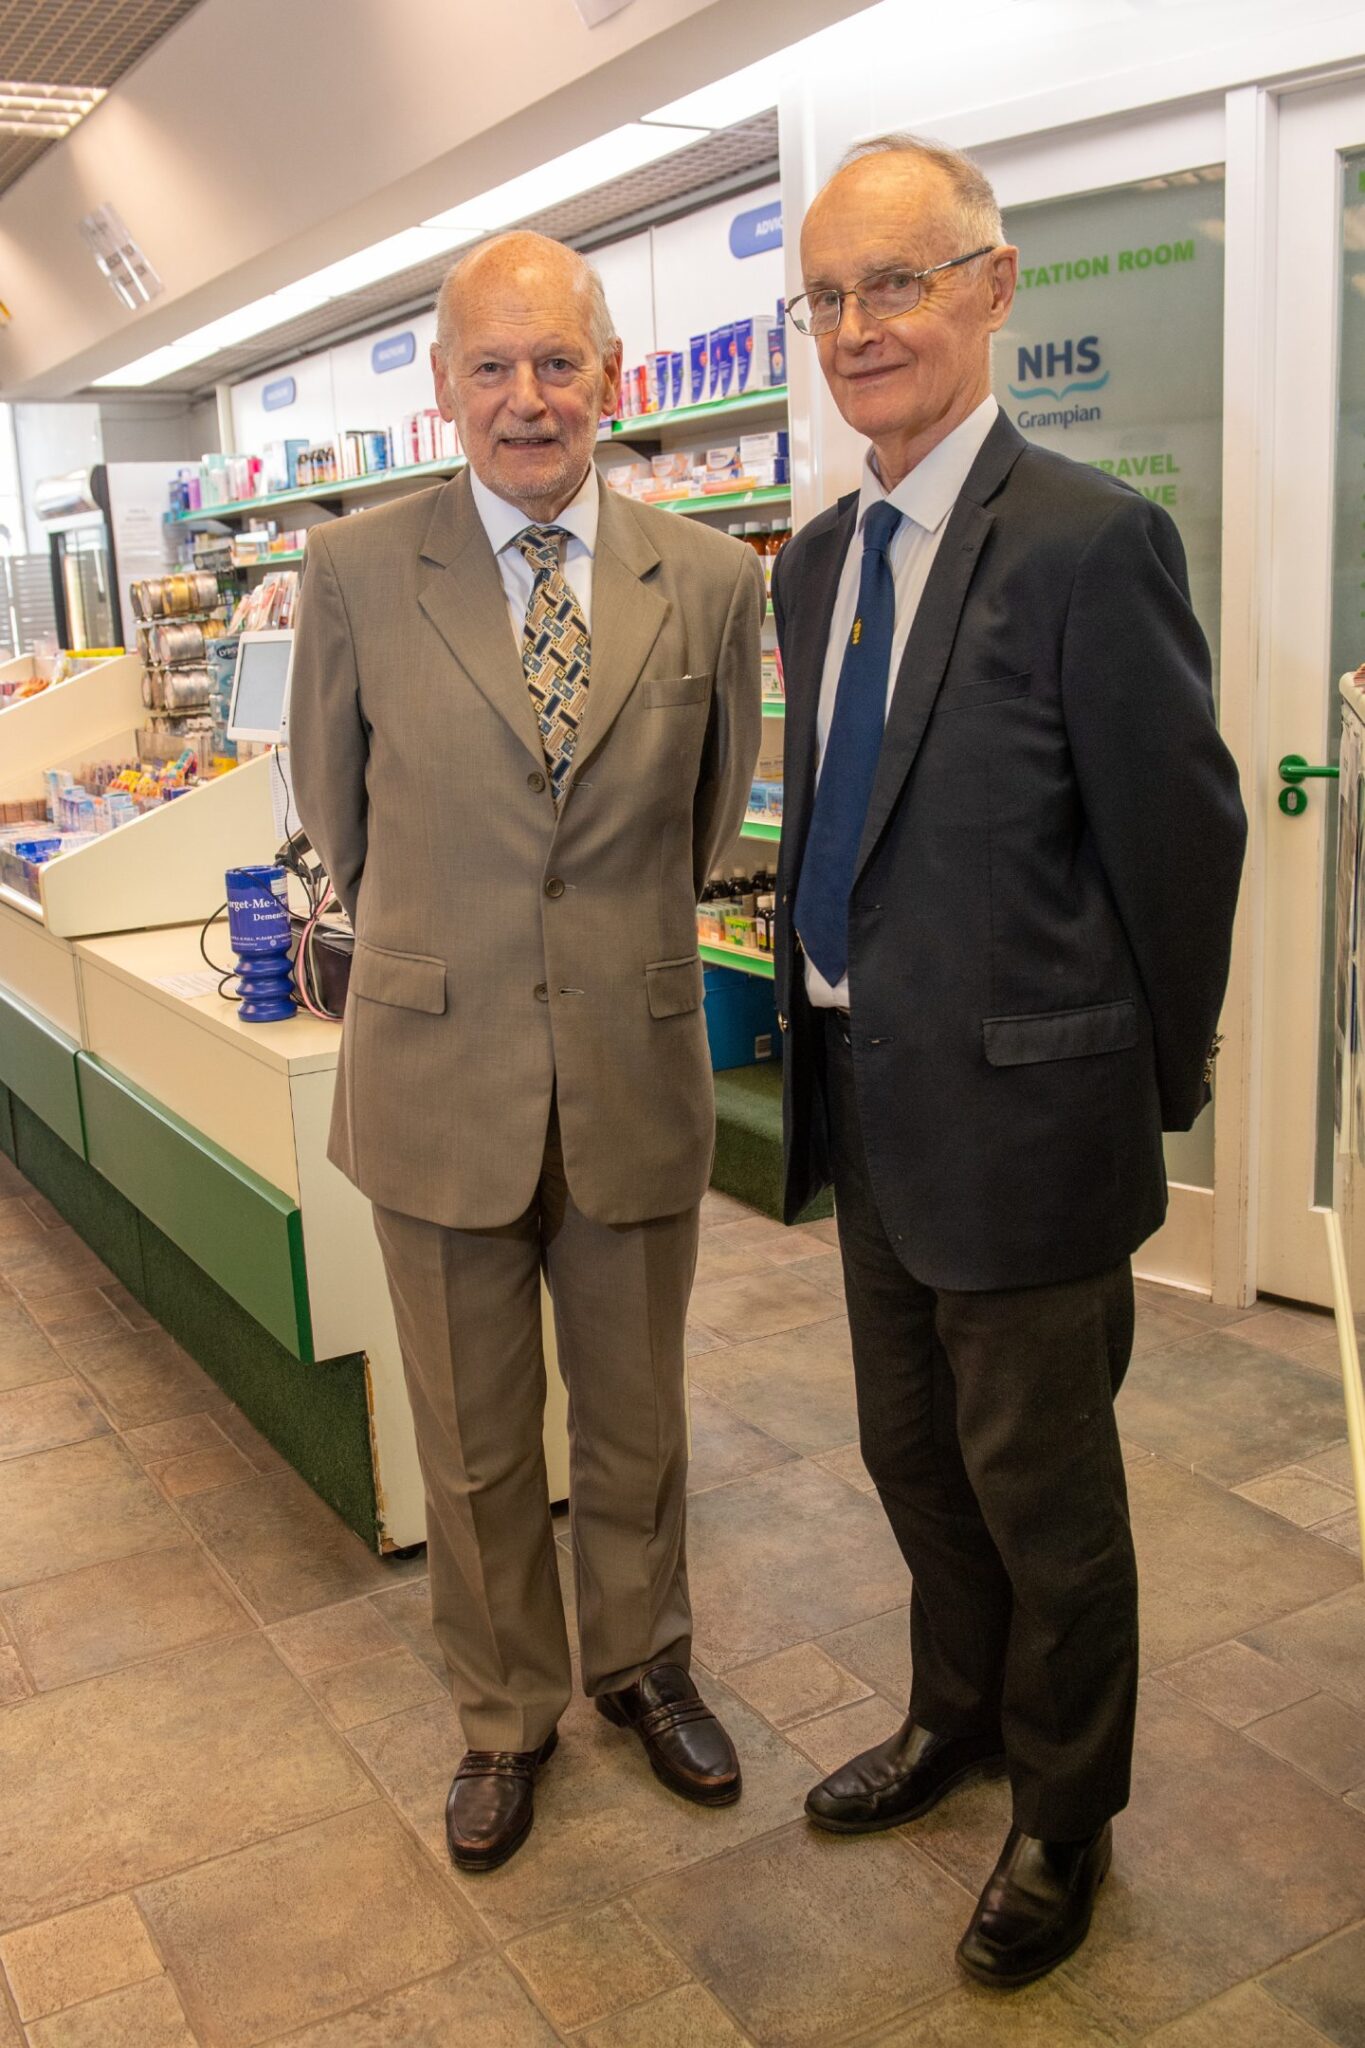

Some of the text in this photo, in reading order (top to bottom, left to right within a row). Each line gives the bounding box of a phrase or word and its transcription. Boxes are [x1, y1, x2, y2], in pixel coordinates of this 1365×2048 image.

[1016, 239, 1196, 290] TATION ROOM
[1018, 336, 1101, 381] NHS
[1017, 405, 1102, 430] Grampian
[1138, 485, 1177, 506] VE
